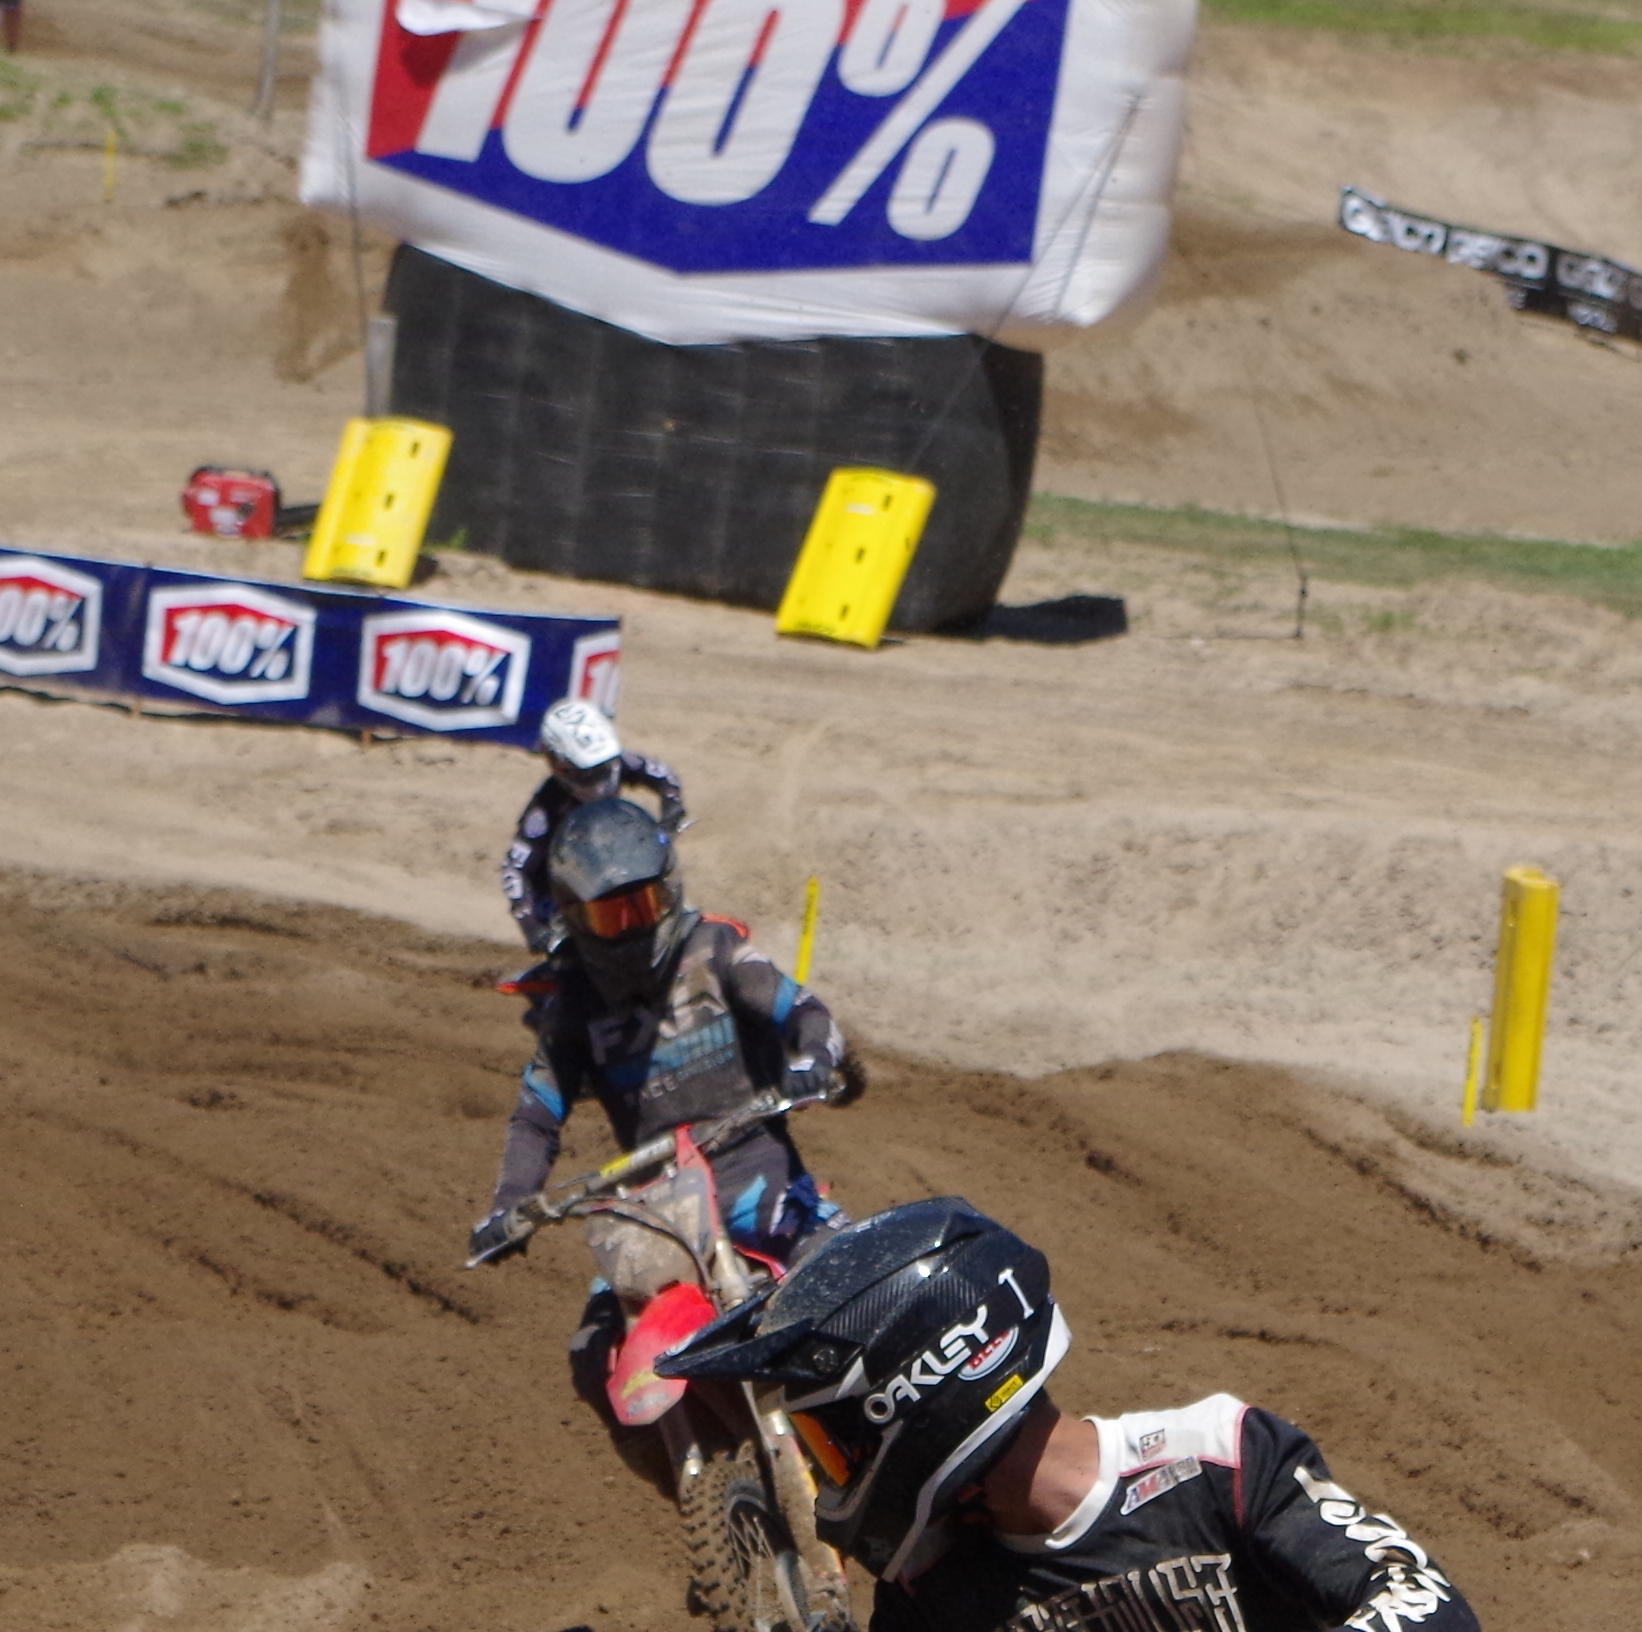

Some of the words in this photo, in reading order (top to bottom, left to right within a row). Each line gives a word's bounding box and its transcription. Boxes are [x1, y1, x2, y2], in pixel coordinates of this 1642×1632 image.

[415, 0, 1021, 241] 100%
[169, 612, 295, 681] 100%
[375, 639, 508, 706] 100%
[864, 1303, 990, 1424] OAKLEY
